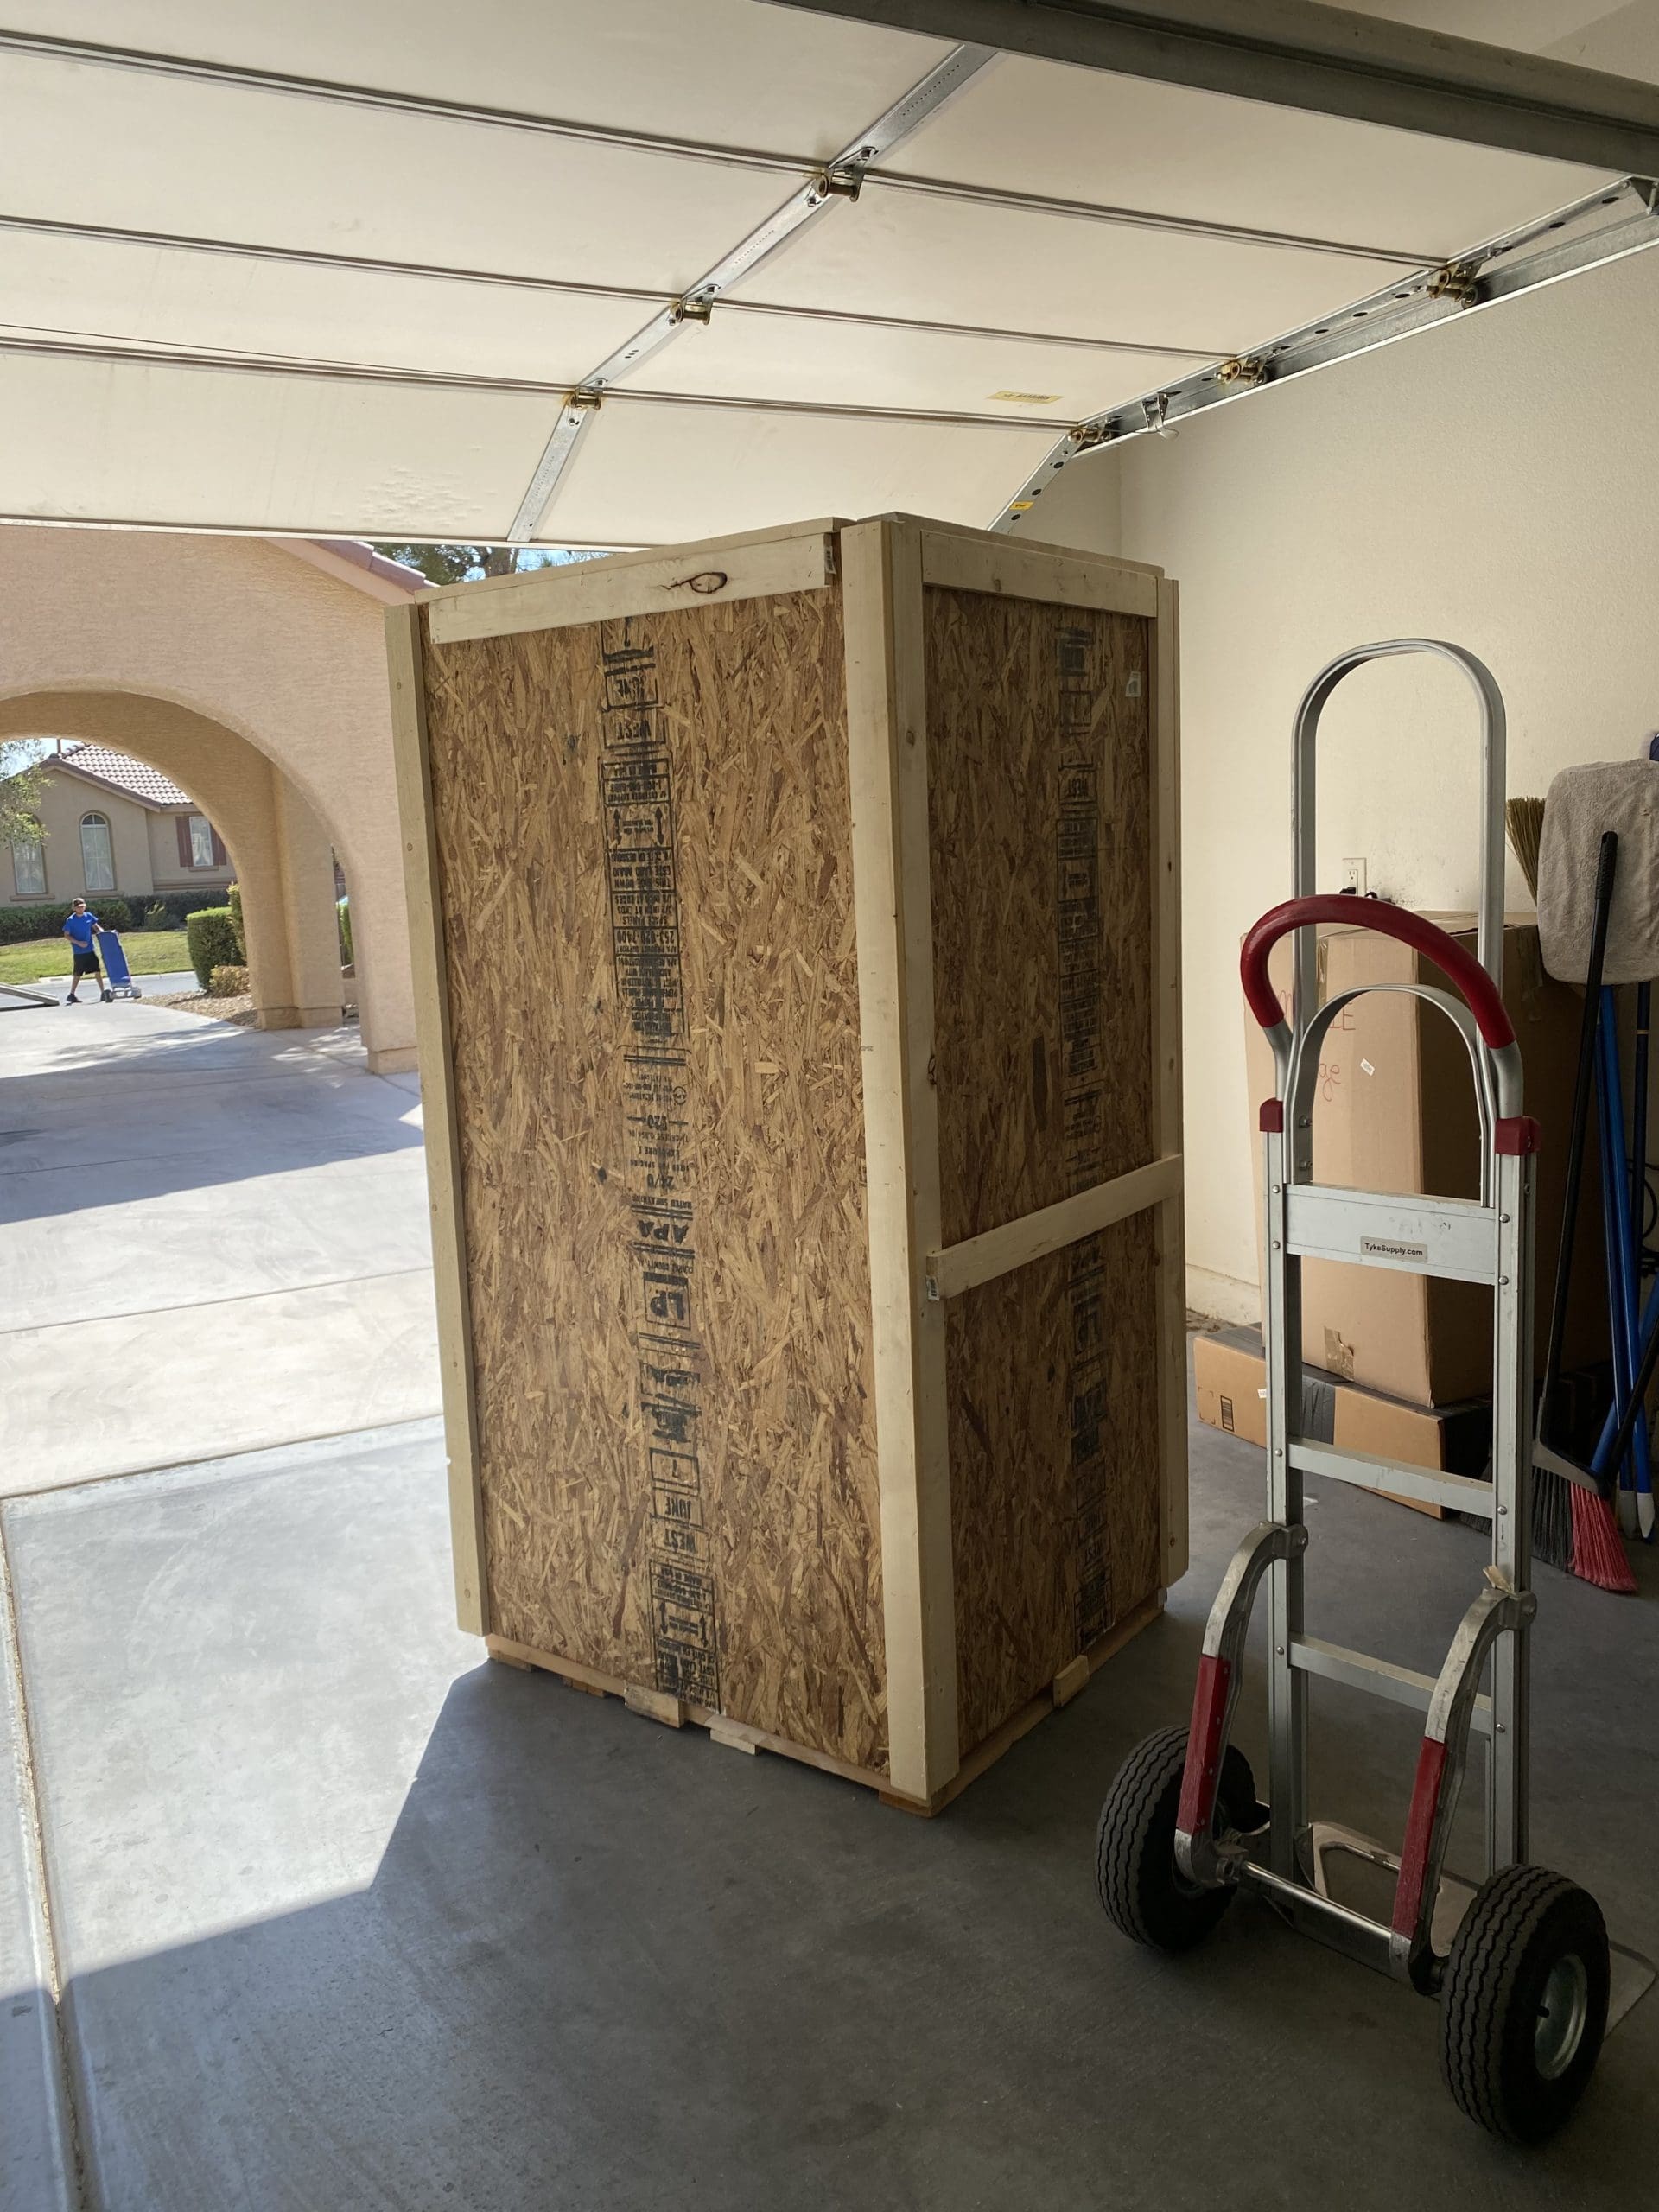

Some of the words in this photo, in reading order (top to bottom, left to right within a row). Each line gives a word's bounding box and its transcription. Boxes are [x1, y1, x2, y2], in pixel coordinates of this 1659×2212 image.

[617, 718, 652, 741] WEST
[656, 878, 671, 888] THIS
[630, 1159, 655, 1169] SPACING
[671, 1199, 691, 1210] RATED
[637, 1220, 689, 1245] APA
[1364, 1243, 1423, 1255] TykeSupply.com
[650, 1291, 684, 1321] LP
[664, 1496, 691, 1521] JUNE
[664, 1529, 696, 1555] WEST
